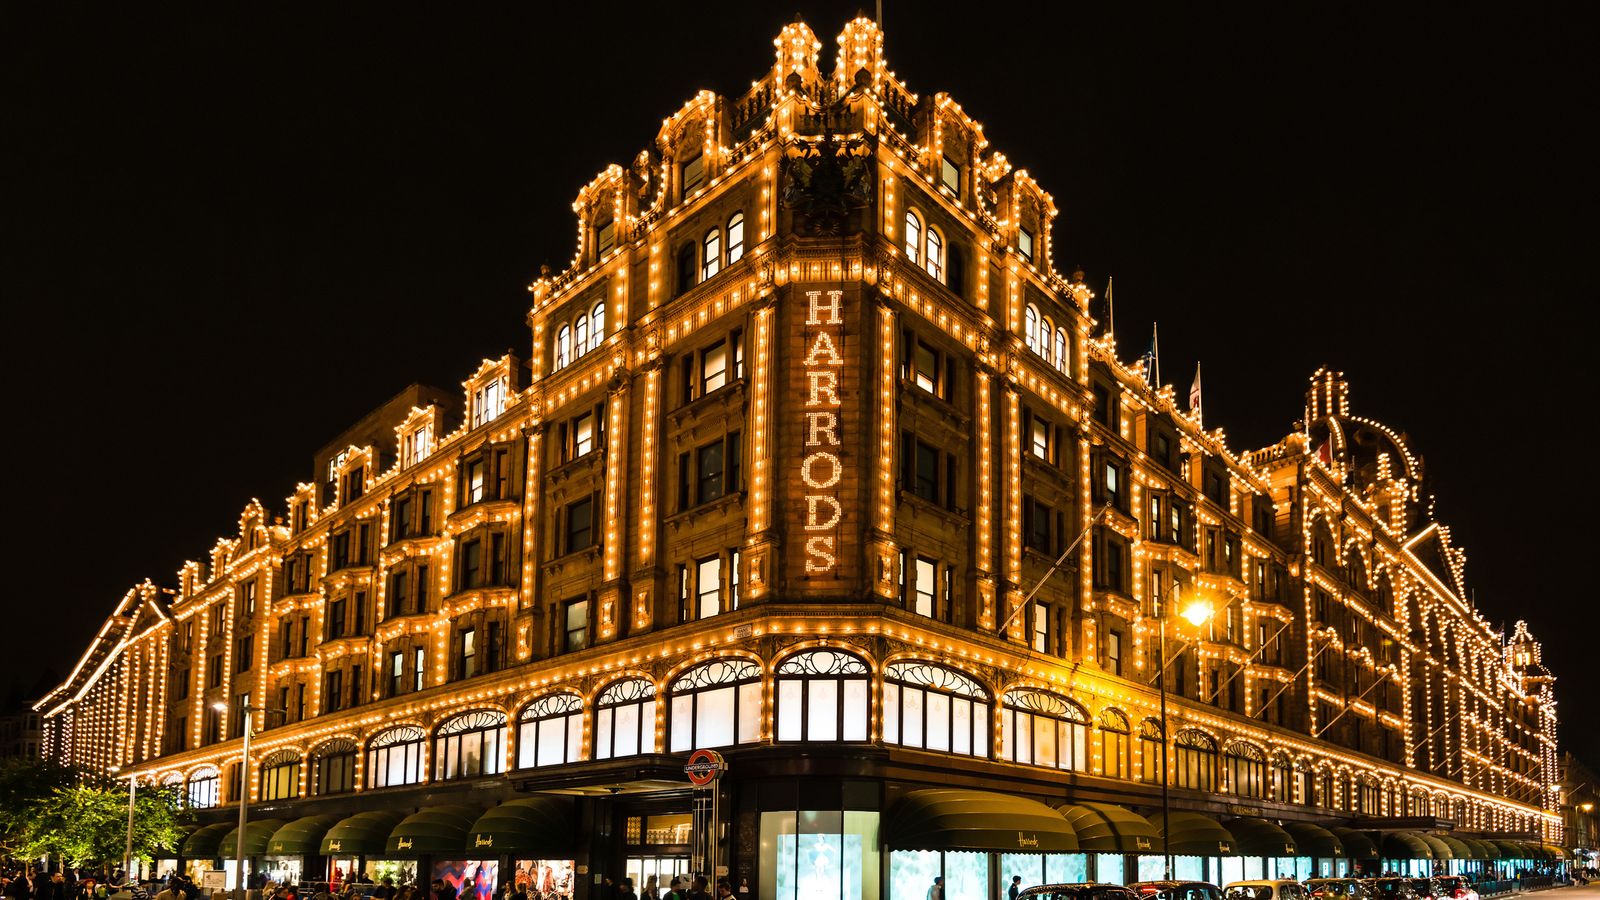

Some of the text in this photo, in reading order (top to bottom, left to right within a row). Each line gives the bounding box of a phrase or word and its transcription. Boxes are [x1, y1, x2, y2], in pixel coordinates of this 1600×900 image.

[801, 290, 843, 572] HARRODS
[685, 763, 719, 771] UNDERGROUND
[1018, 832, 1039, 847] Harrods
